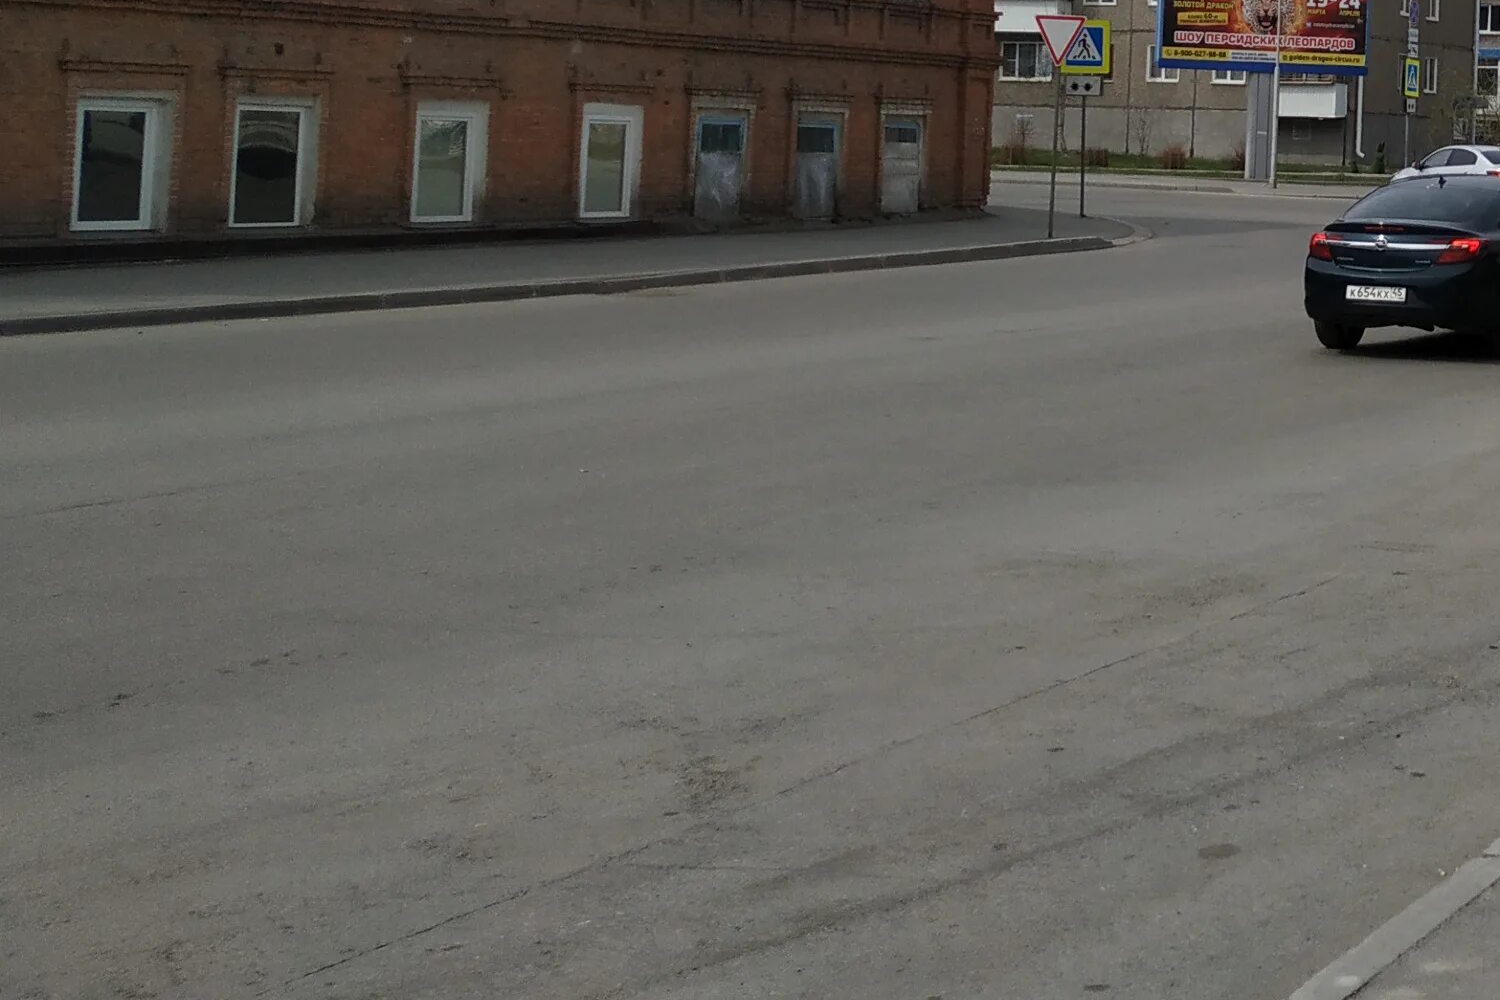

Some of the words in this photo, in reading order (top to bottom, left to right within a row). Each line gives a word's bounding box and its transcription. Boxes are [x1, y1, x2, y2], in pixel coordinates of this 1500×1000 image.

[1173, 0, 1205, 8] ЗОЛОТОЙ
[1206, 1, 1233, 10] ДРАКОН
[1175, 32, 1203, 42] ШОУ
[1206, 33, 1284, 46] ПЕРСИДСКИХ
[1287, 36, 1354, 49] ЛЕОПАРДОВ
